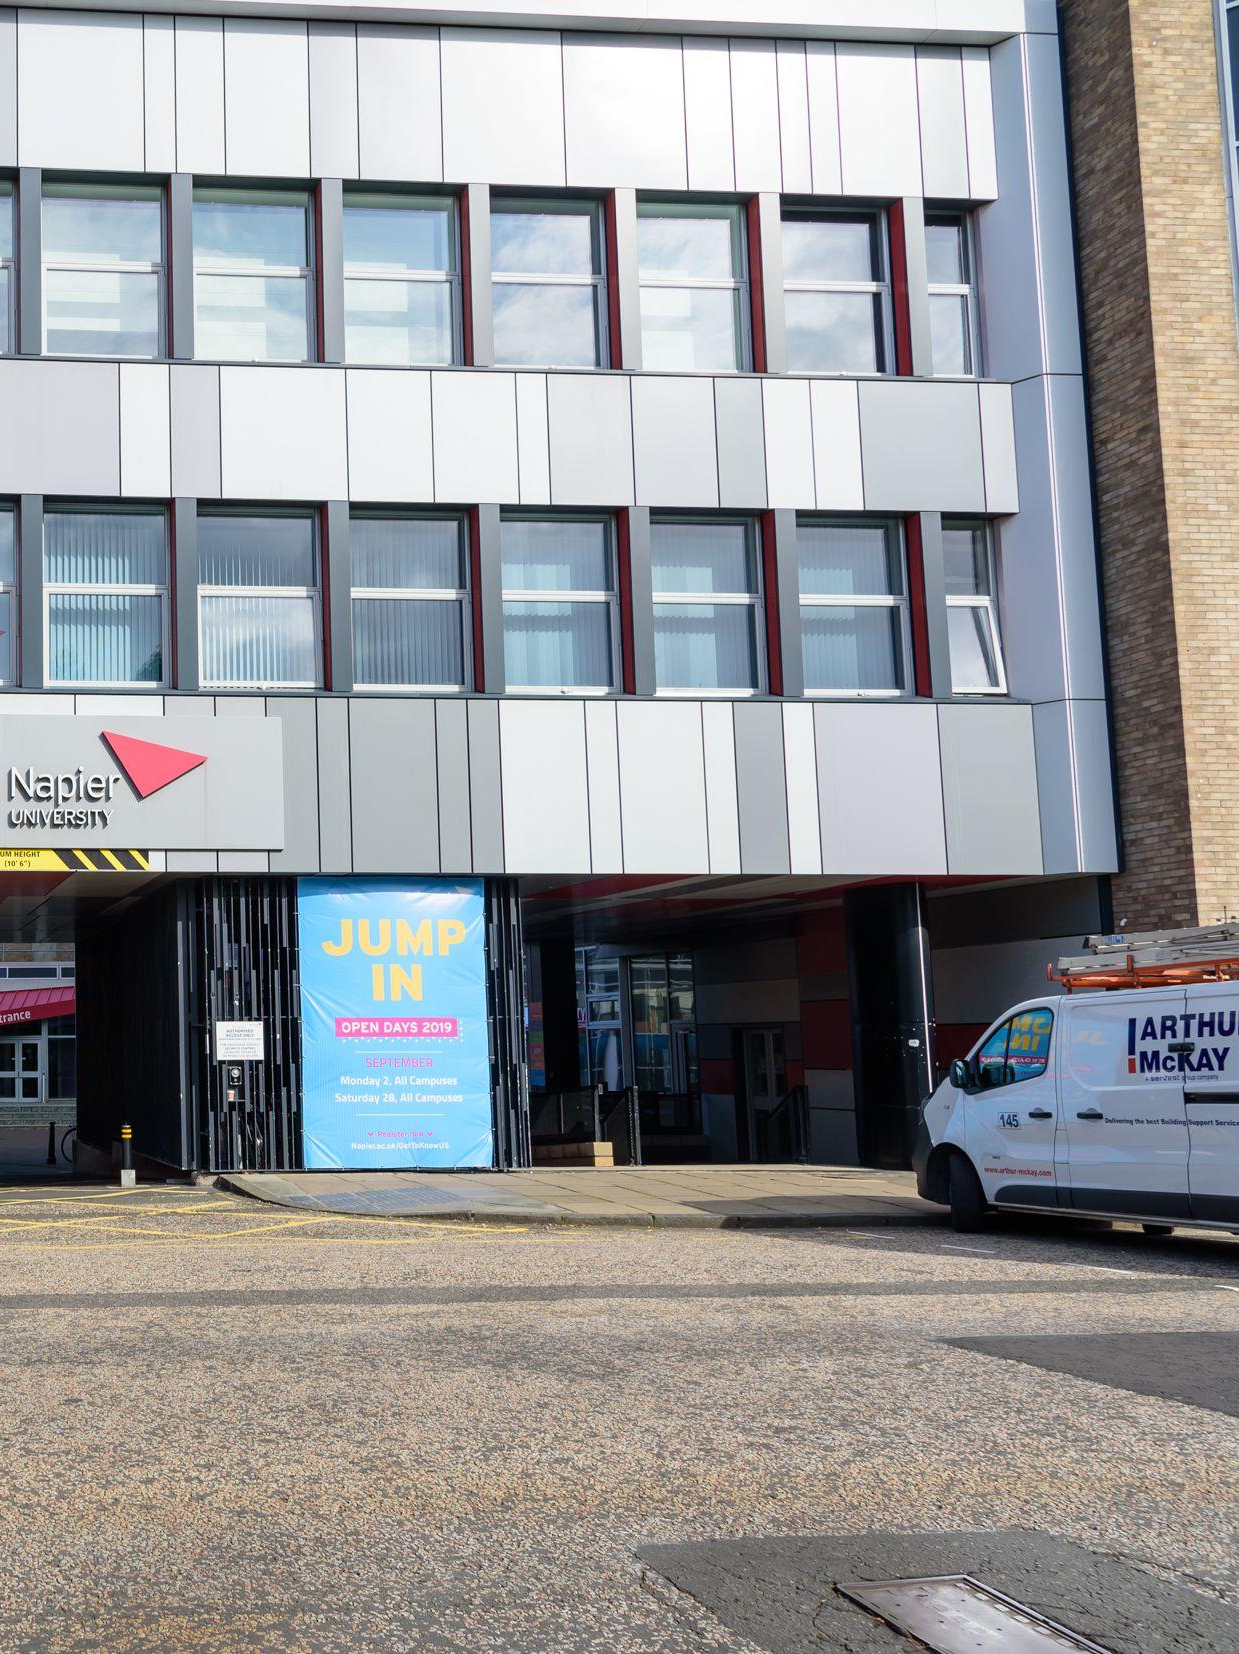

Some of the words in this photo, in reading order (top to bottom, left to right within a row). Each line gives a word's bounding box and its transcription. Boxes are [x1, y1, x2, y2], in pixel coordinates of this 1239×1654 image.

[8, 766, 121, 805] Napier
[8, 808, 113, 828] UNIVERSITY
[13, 850, 41, 858] HEIGHT
[321, 918, 467, 956] JUMP
[371, 963, 424, 1002] IN
[341, 1022, 379, 1033] OPEN
[383, 1022, 418, 1033] DAYS
[422, 1022, 452, 1033] 2019
[1140, 1010, 1239, 1041] ARTHU
[365, 1058, 433, 1068] SEPTEMBER
[1139, 1047, 1231, 1074] McKAY
[340, 1075, 381, 1086] Monday
[394, 1075, 408, 1086] All
[409, 1075, 458, 1086] Campuses
[335, 1092, 380, 1104] Saturday
[382, 1092, 398, 1104] 28,
[400, 1092, 414, 1103] All
[415, 1092, 463, 1104] Campuses
[1000, 1114, 1019, 1127] 145
[1104, 1117, 1134, 1126] Delivering
[1161, 1119, 1187, 1127] Building
[1187, 1119, 1214, 1127] Support
[377, 1130, 408, 1138] Register
[984, 1167, 1052, 1177] www.arthur-mckay.com
